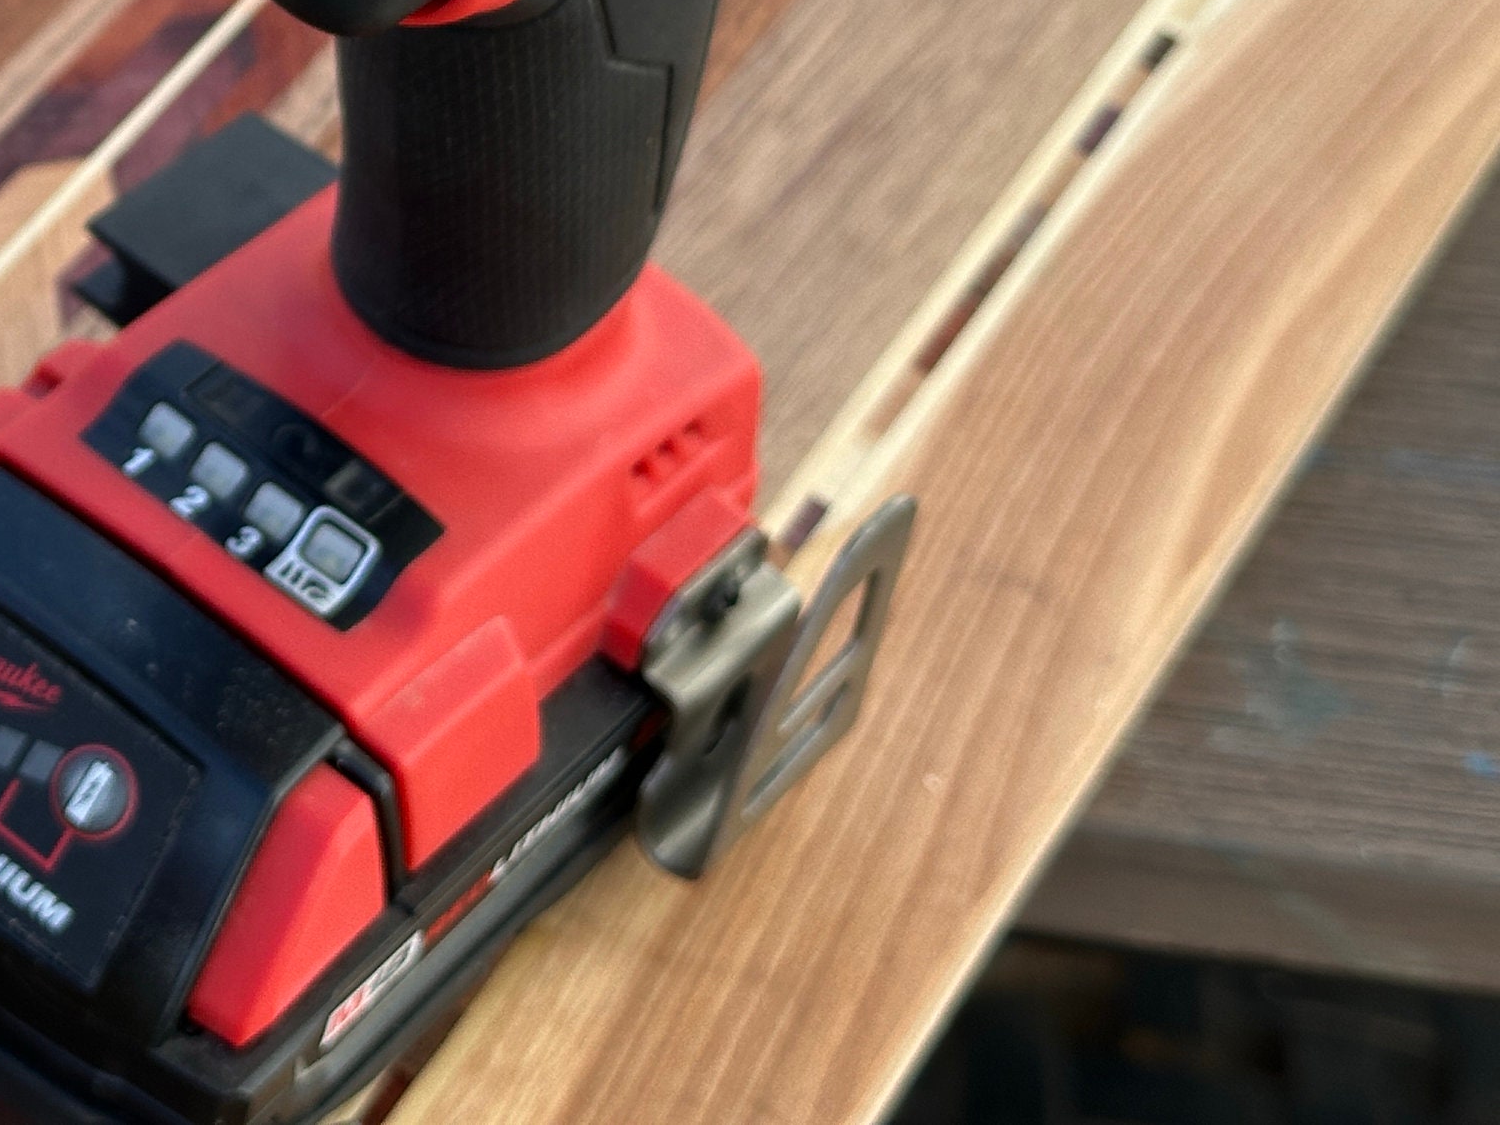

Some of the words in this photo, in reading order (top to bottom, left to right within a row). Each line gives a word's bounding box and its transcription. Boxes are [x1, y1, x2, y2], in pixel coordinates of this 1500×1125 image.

[123, 446, 154, 475] 1
[169, 484, 209, 518] 2
[225, 525, 262, 558] 3
